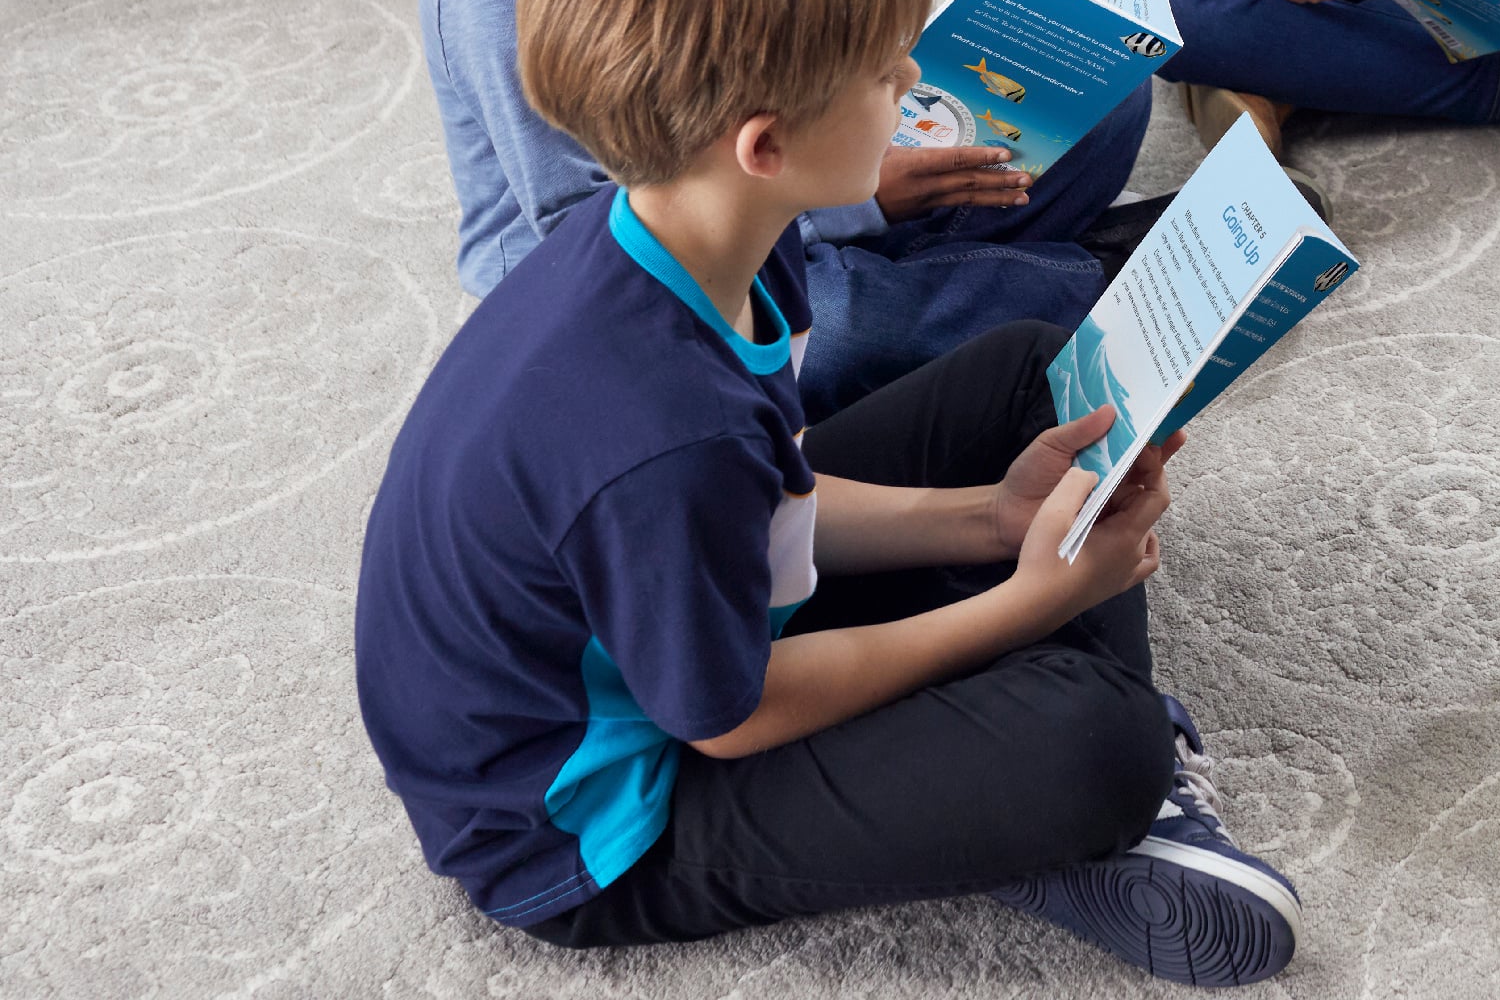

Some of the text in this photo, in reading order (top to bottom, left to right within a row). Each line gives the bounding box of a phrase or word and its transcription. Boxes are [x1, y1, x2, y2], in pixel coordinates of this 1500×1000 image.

[900, 105, 920, 118] DES
[1222, 205, 1260, 265] Going Up
[1241, 202, 1267, 239] CHAPTER 5
